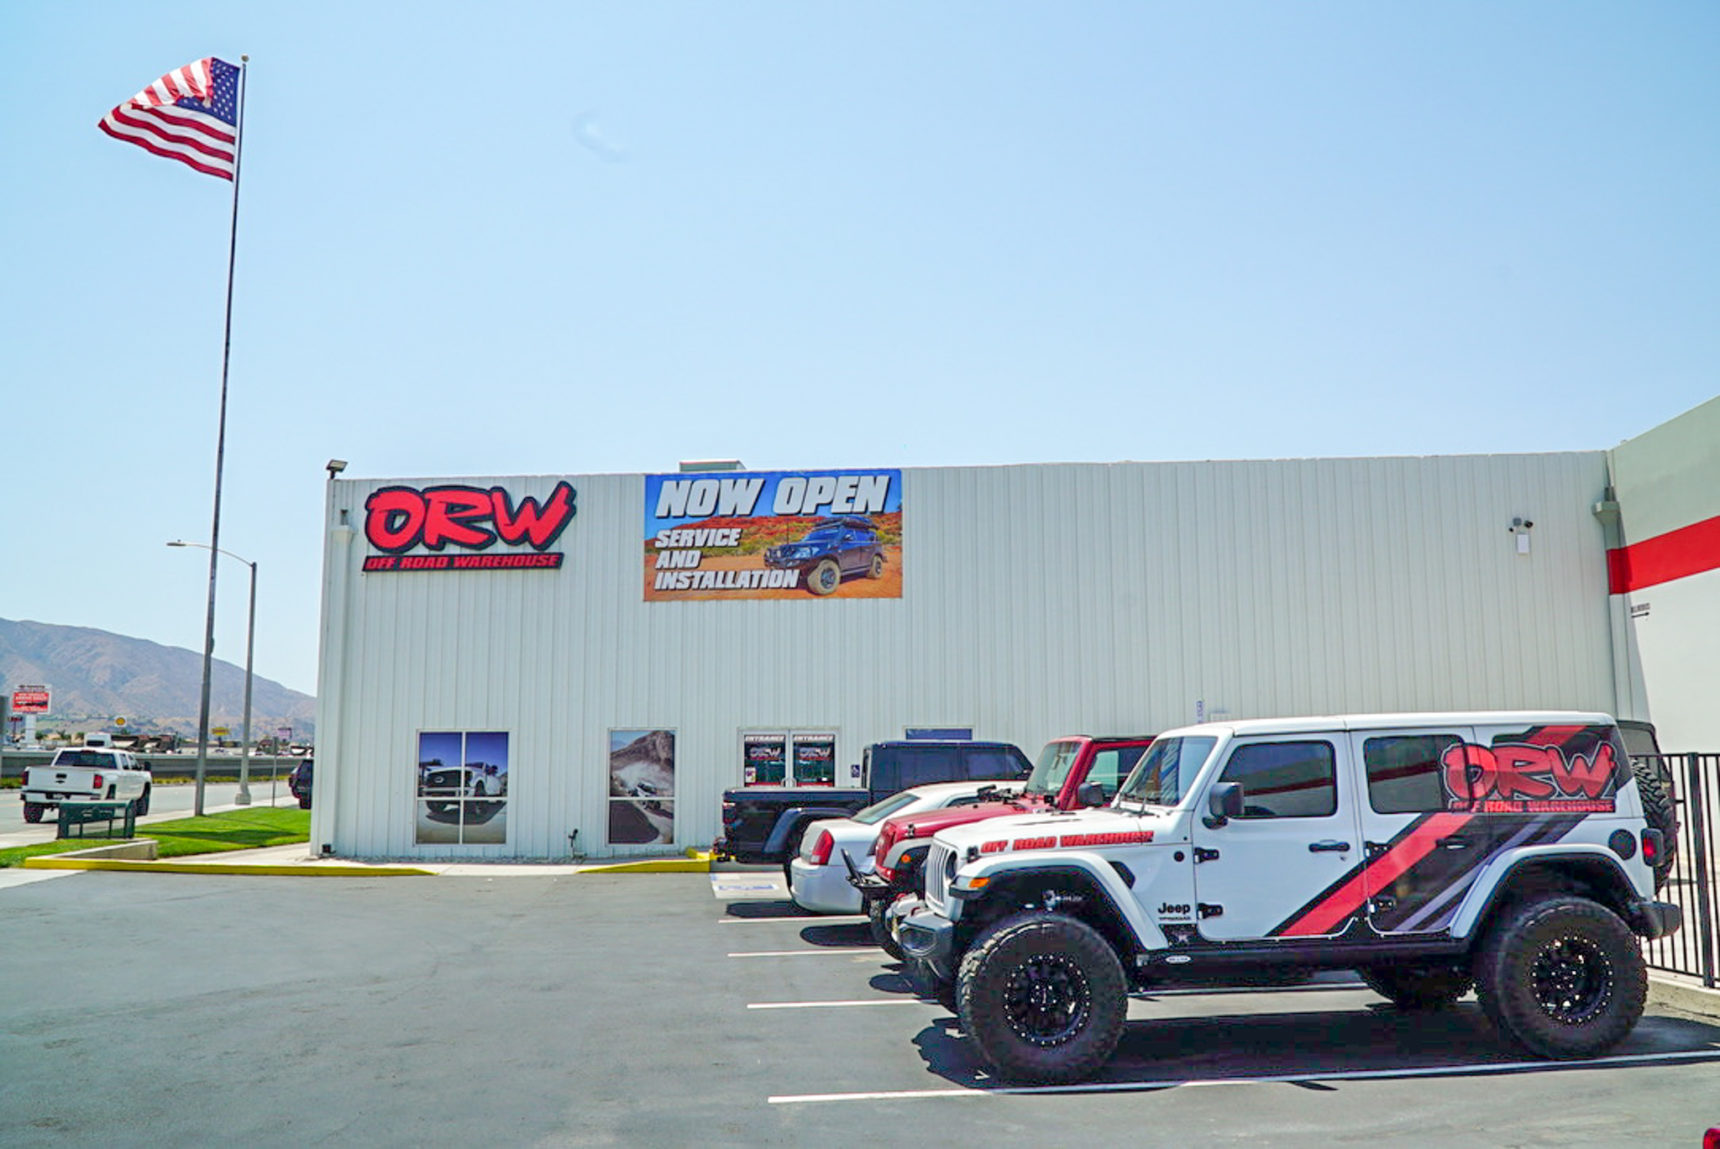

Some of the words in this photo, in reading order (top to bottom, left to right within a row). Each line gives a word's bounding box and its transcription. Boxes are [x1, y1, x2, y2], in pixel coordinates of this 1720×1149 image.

[656, 478, 765, 518] NOW
[773, 475, 891, 514] OPEN
[366, 482, 575, 552] ORW
[655, 528, 742, 548] SERVICE
[365, 556, 397, 569] OFF
[401, 556, 448, 569] ROAD
[453, 554, 560, 568] WAREHOUSE
[655, 550, 702, 569] AND
[655, 569, 800, 590] INSTALLATION
[1442, 741, 1617, 799] ORW
[1484, 800, 1524, 812] ROAD
[1526, 800, 1614, 812] WAREHOUSE
[980, 840, 1008, 853] OFF
[1012, 836, 1057, 850] ROAD
[1060, 830, 1154, 848] WAREHOUSE
[1158, 902, 1190, 915] Jeep
